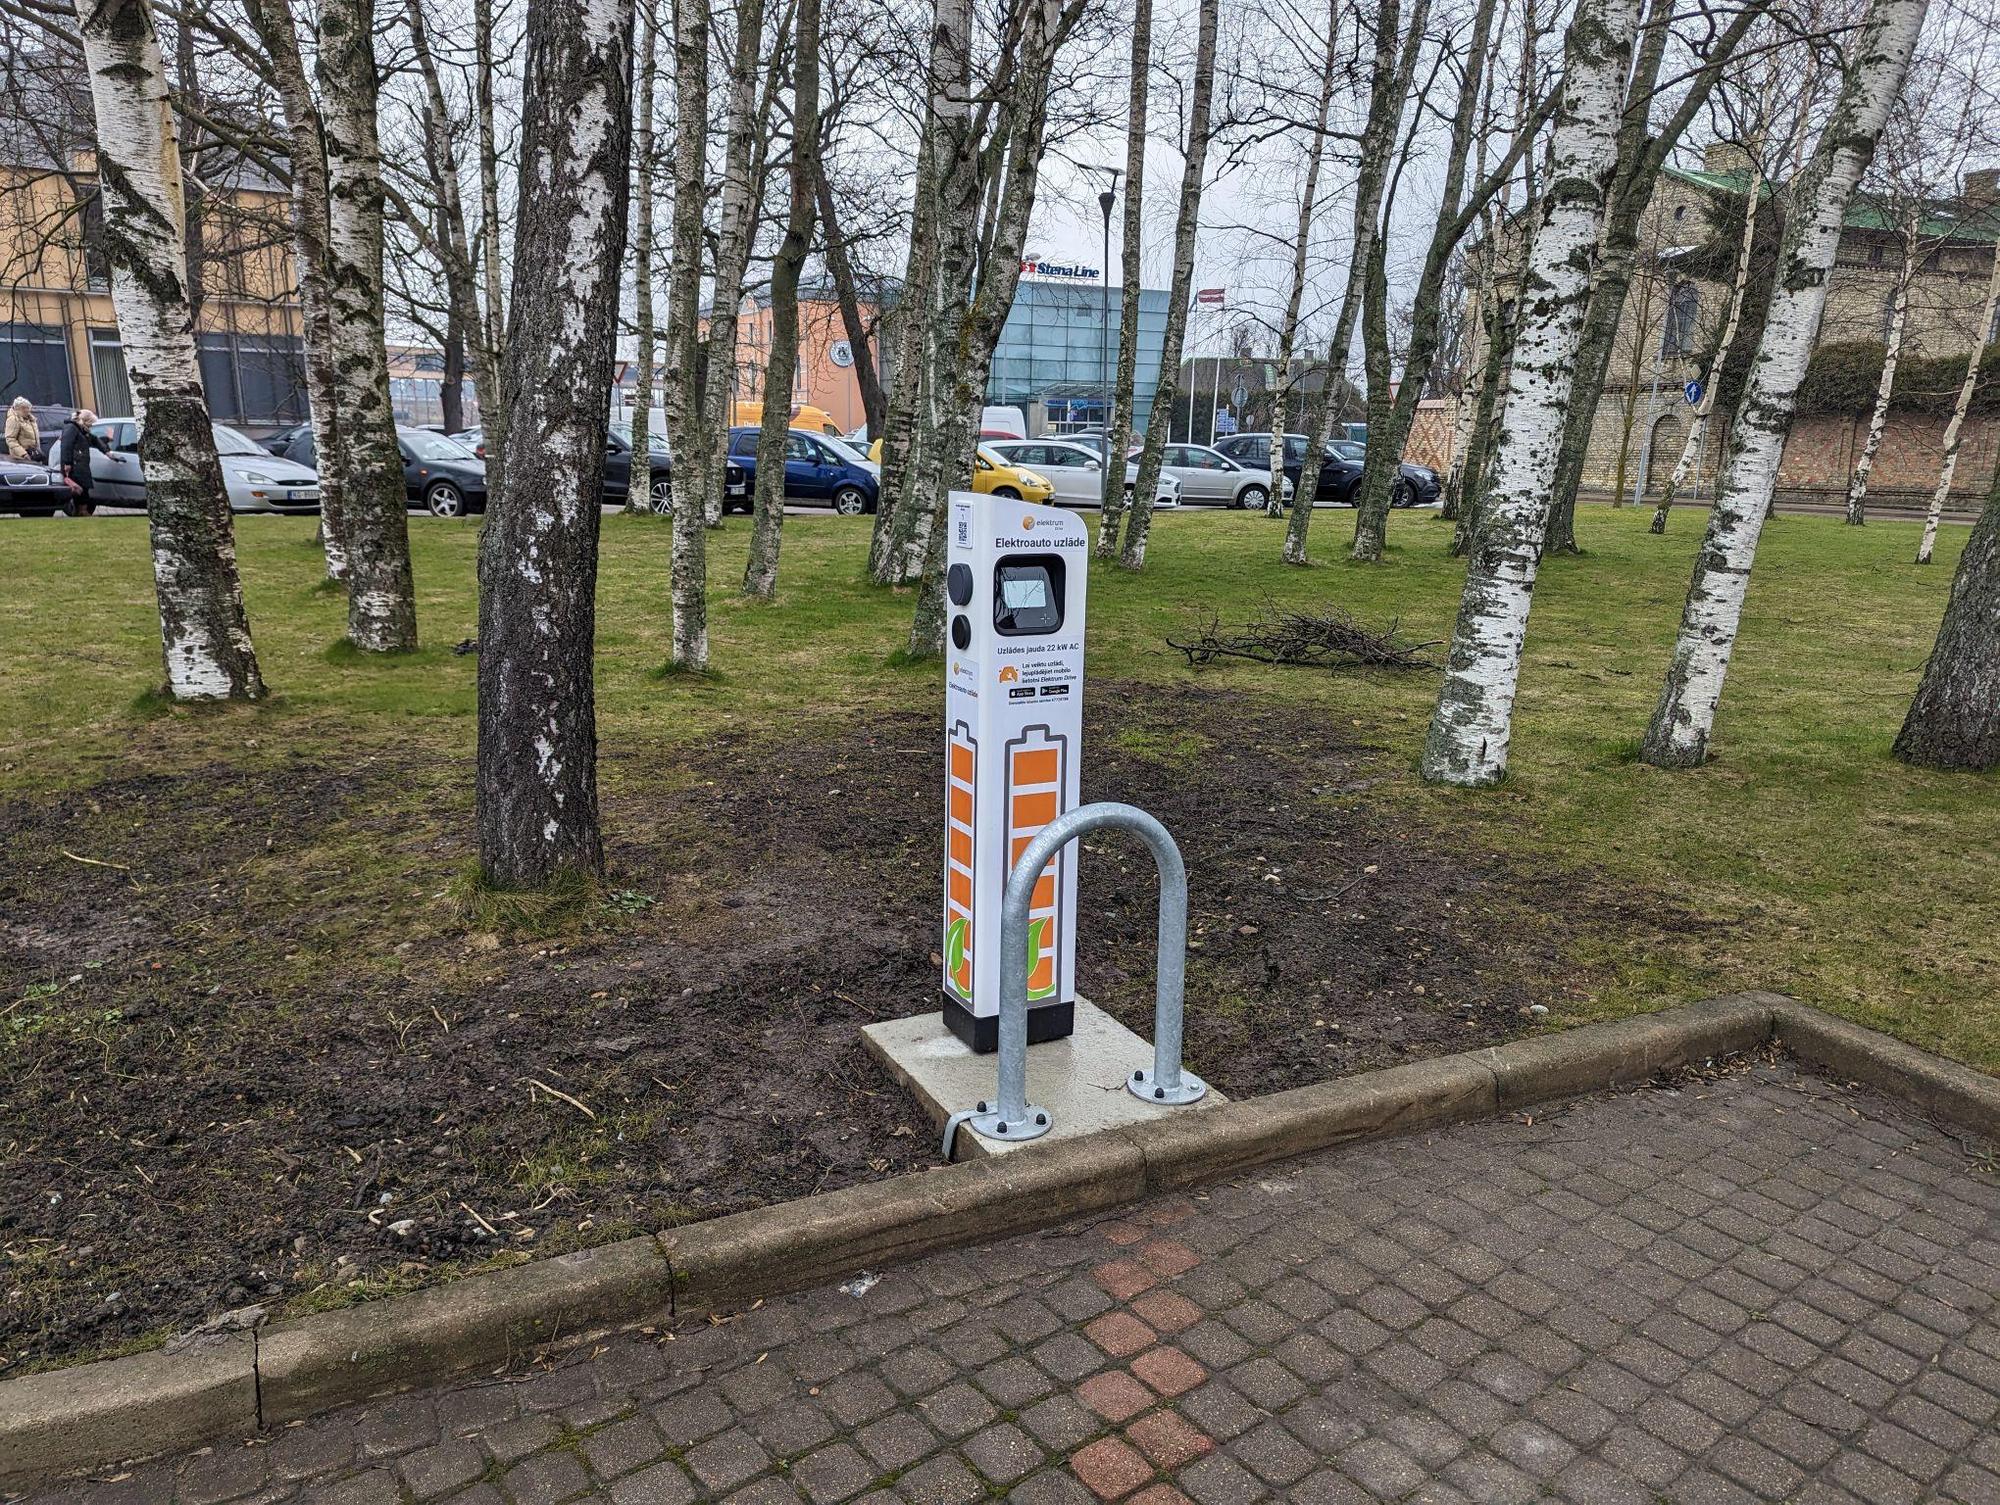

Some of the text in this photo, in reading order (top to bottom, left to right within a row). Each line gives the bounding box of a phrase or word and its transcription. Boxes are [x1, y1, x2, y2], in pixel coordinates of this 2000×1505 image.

[1037, 262, 1100, 278] Stena Line
[995, 537, 1086, 548] Elektroauto uzlāde
[997, 647, 1025, 655] Uzlādes
[1026, 645, 1046, 655] jauda
[1057, 643, 1068, 651] kW
